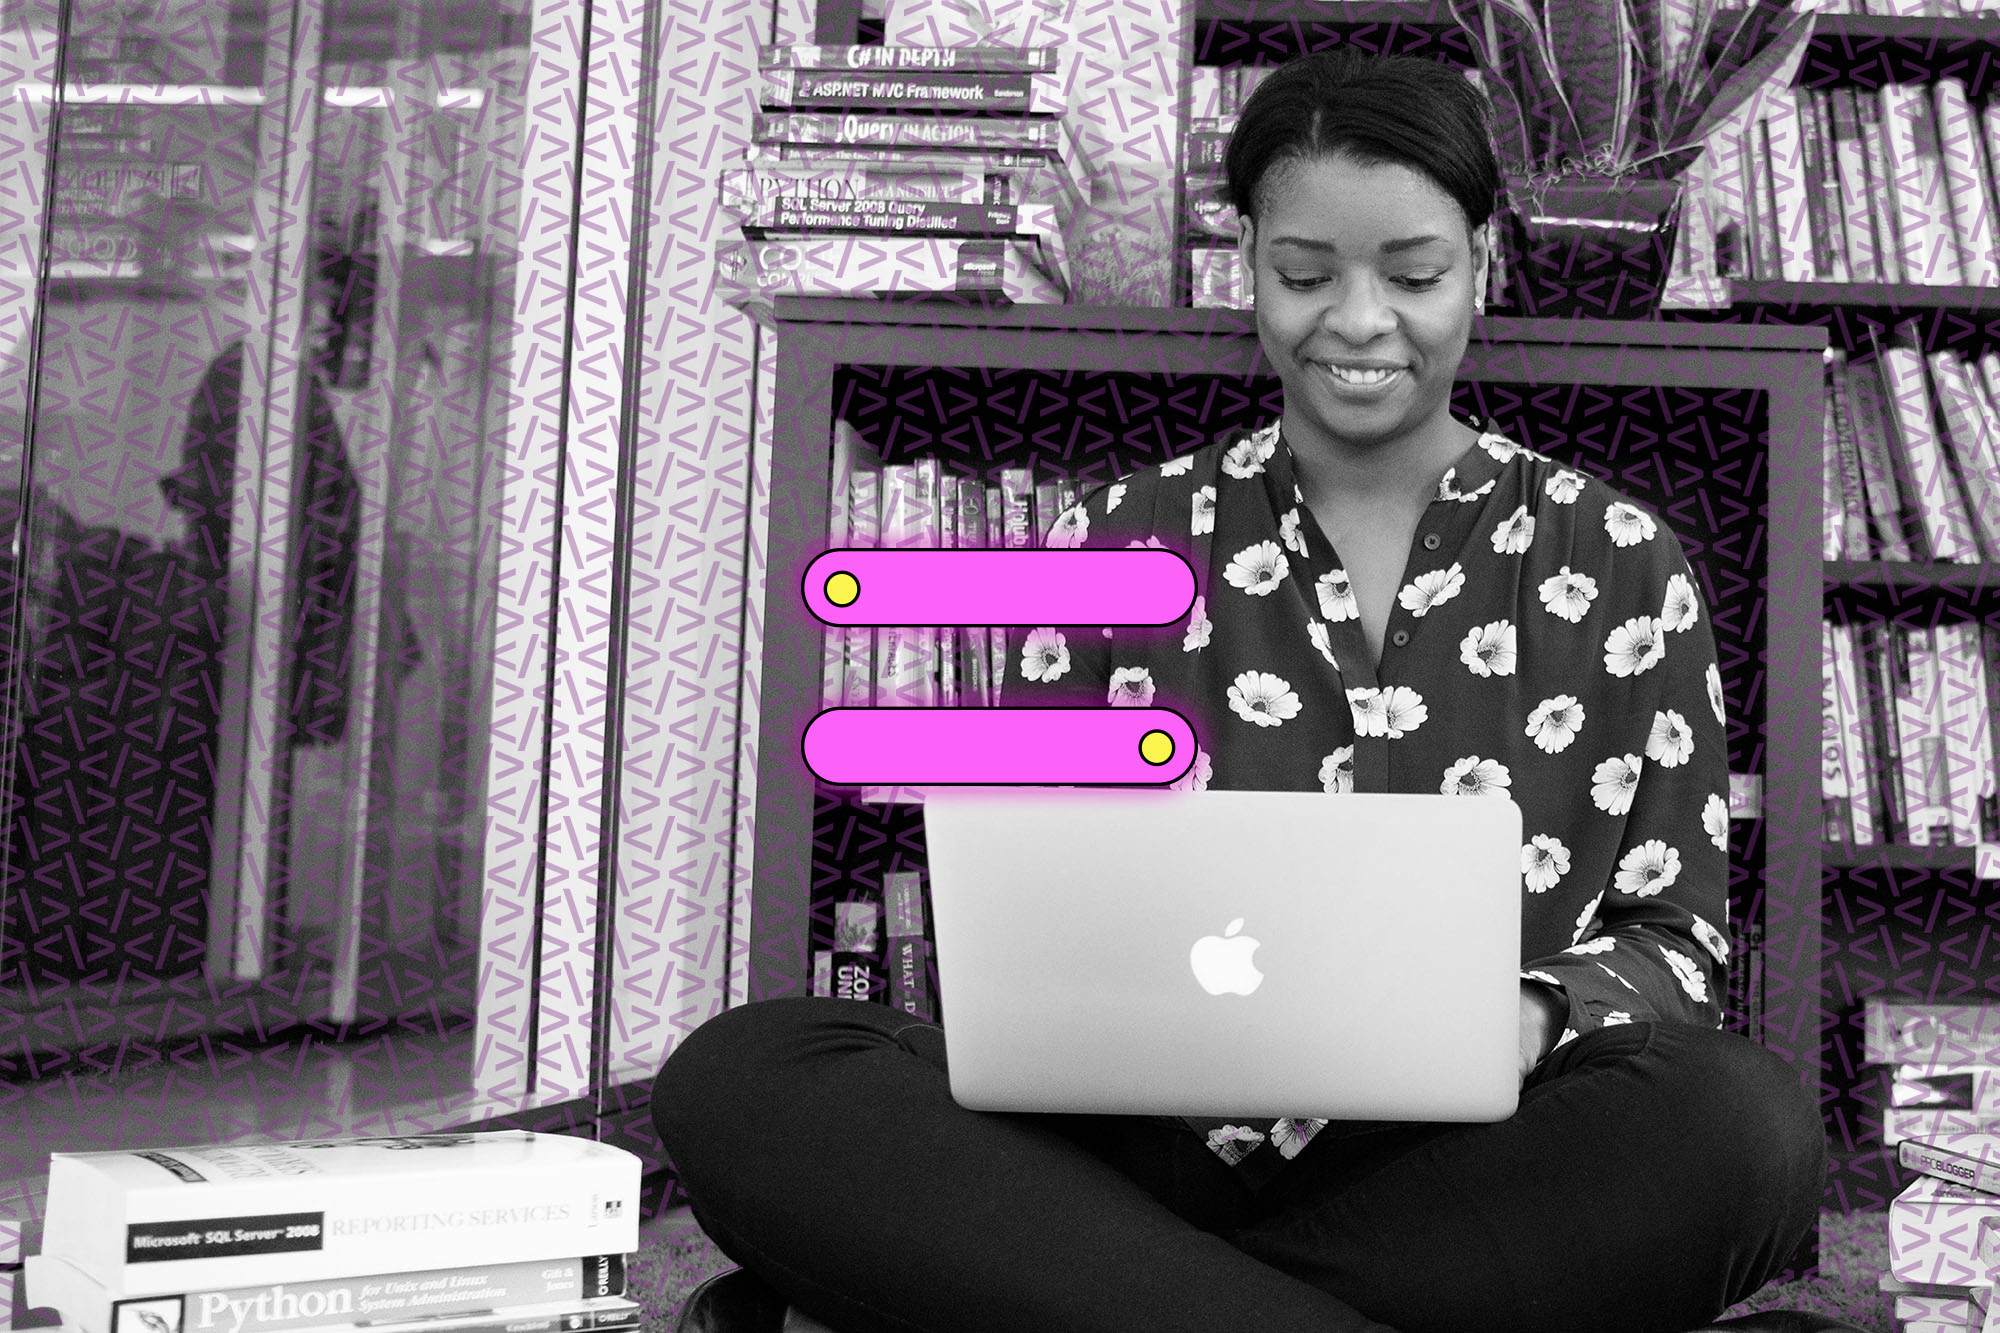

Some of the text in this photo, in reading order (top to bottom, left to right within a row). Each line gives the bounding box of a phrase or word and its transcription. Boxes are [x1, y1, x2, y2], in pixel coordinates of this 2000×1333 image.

[847, 45, 956, 68] C# IN DEPTH
[812, 81, 984, 99] ASP.NET MVC Framework
[834, 115, 976, 145] jQuery IN ACTION
[760, 177, 859, 200] PYTHON
[781, 198, 926, 217] SQL Server 2008 Query
[780, 211, 958, 230] Performance Tuning Distilled
[1012, 501, 1029, 545] Holub
[902, 943, 914, 988] WHAT
[332, 1203, 571, 1236] REPORTING SERVICES
[133, 1224, 321, 1249] Microsoft SQL Server 2008
[198, 1286, 354, 1333] Python
[384, 1280, 419, 1295] Unix
[420, 1277, 449, 1291] and
[450, 1275, 489, 1288] Linux
[358, 1287, 508, 1313] System Administration
